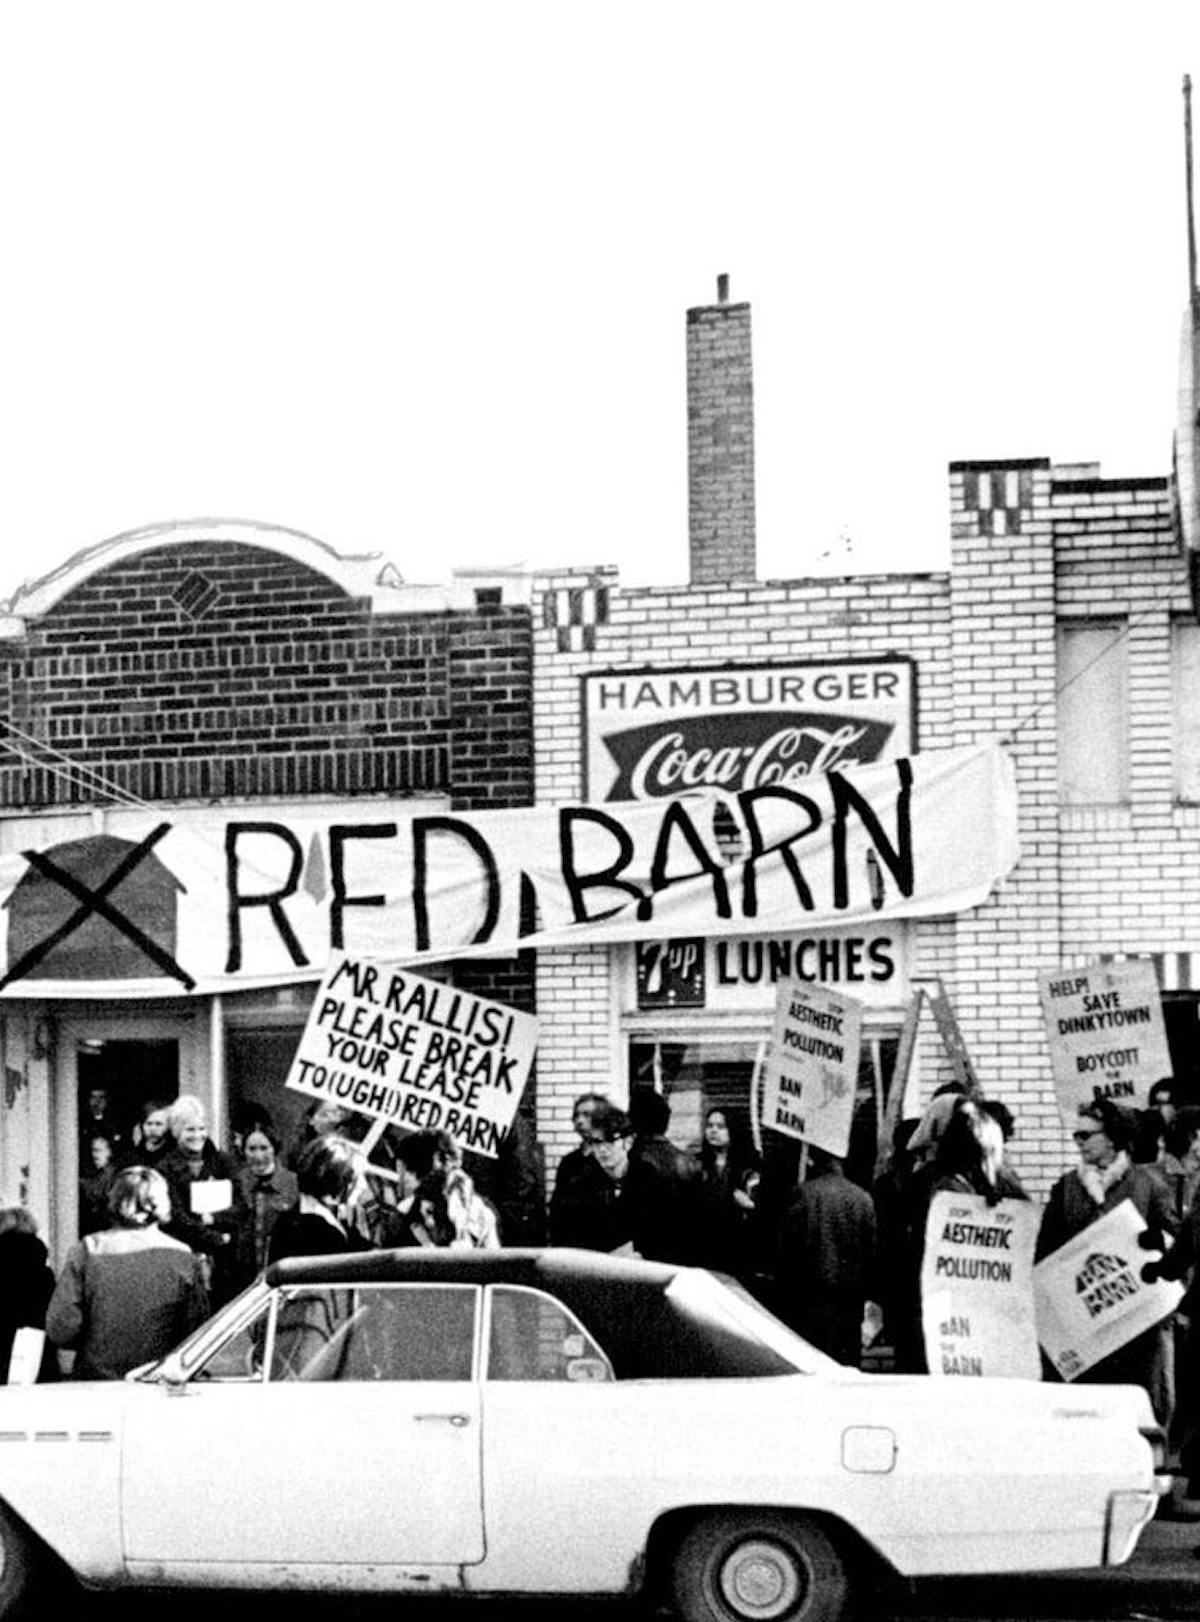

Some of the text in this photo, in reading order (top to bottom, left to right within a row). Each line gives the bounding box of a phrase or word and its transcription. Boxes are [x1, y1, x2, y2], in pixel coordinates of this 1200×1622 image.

[600, 671, 899, 710] HAMBURGER
[558, 758, 914, 923] BARN
[717, 937, 895, 984] LUNCHES
[385, 974, 515, 1053] RALLIS!
[788, 1001, 844, 1036] AESTHETIC
[1082, 991, 1120, 1013] SAVE
[1057, 1005, 1152, 1036] DINKYTOWN
[317, 998, 518, 1094] PLEASE BREAK
[783, 1028, 844, 1063] POLLUTION
[1076, 1048, 1140, 1073] BOYCOTT
[327, 1033, 482, 1110] YOUR LEASE
[779, 1075, 803, 1099] BAN
[1093, 1080, 1136, 1100] BARN
[400, 1093, 442, 1128] RED
[445, 1108, 508, 1154] BARN
[775, 1108, 806, 1134] BARN
[942, 1223, 1014, 1250] AESTHETIC
[935, 1256, 1013, 1282] POLLUTION
[941, 1355, 984, 1377] BARN
